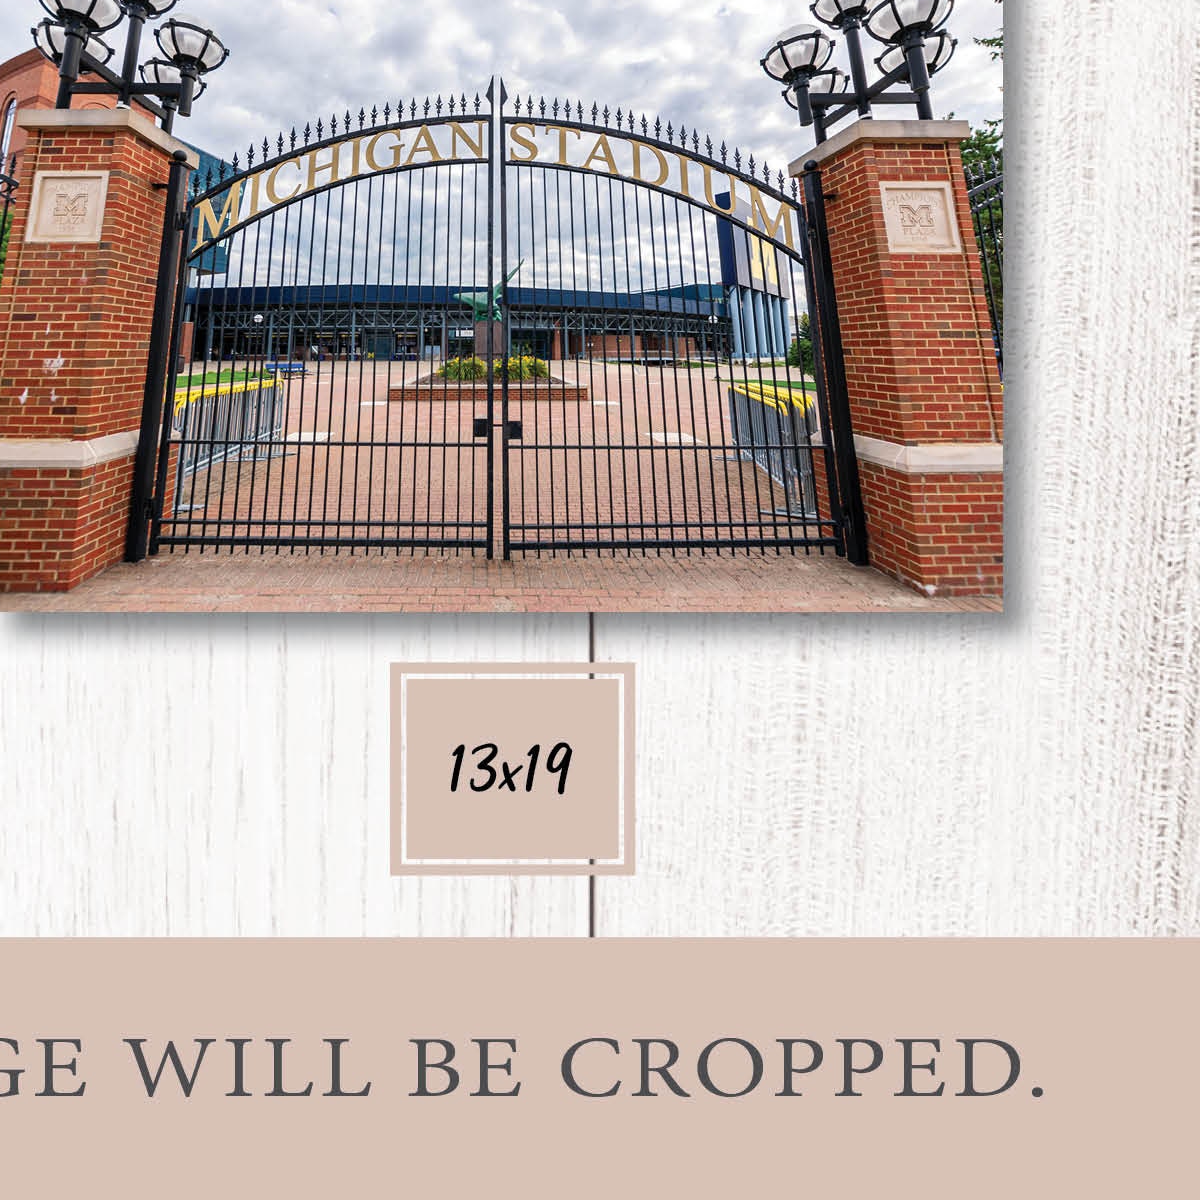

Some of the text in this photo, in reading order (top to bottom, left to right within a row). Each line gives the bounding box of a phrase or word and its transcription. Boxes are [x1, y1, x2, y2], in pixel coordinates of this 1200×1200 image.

[191, 120, 794, 254] MICHIGAN STADIUM
[53, 193, 89, 217] M
[899, 204, 935, 228] M
